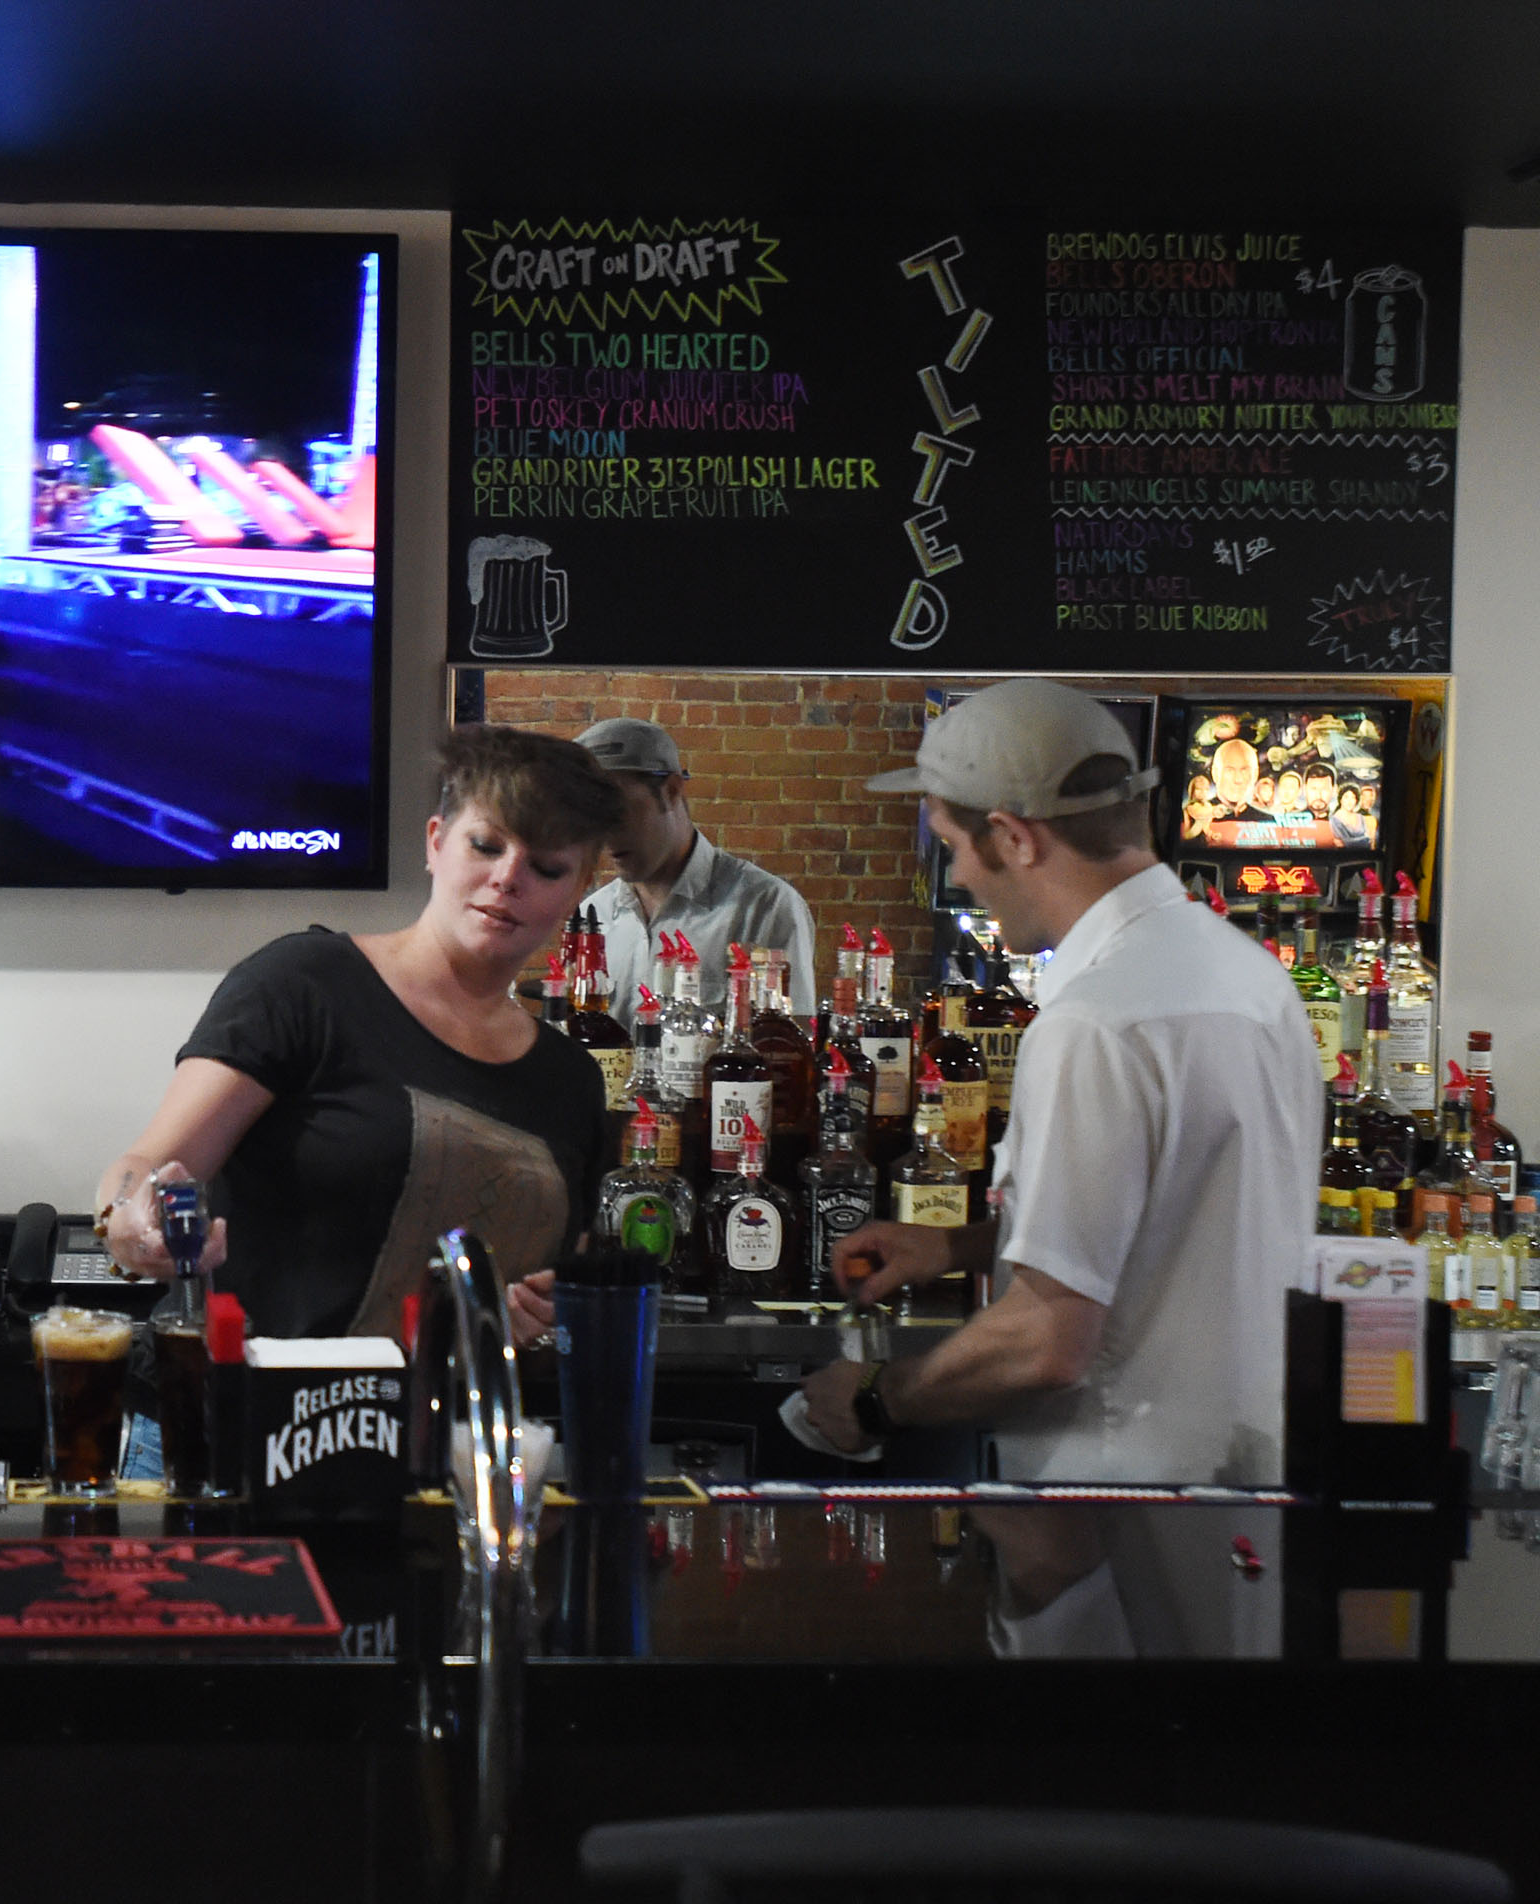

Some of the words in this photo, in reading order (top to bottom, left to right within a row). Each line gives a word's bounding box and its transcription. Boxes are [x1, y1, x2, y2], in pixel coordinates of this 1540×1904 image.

[1046, 232, 1158, 261] BREWDOG
[1164, 232, 1227, 261] ELVIS
[1236, 233, 1304, 262] JUICE
[490, 243, 596, 292] CRAFT
[635, 237, 741, 287] DRAFT
[1045, 261, 1125, 288] BELLS
[1133, 261, 1237, 289] OBERON
[1294, 258, 1343, 300] $4
[1045, 290, 1161, 319] FOUNDERS
[1046, 318, 1105, 345] NEW
[1372, 294, 1397, 395] CANS
[471, 331, 556, 367] BELLS
[564, 332, 630, 368] TWO
[641, 332, 770, 371] HEARTED
[1047, 346, 1125, 372] BELLS
[1136, 346, 1248, 372] OFFICIAL
[472, 367, 535, 397] NEW
[536, 368, 646, 400] BELGIUM
[772, 373, 810, 404] IPA
[1052, 375, 1148, 401] SHORTS
[1153, 375, 1222, 401] MELT
[1230, 375, 1267, 400] MY
[1273, 375, 1347, 400] BRAIN
[474, 398, 608, 430] PETOSKEY
[617, 400, 718, 431] CRANIUM
[722, 402, 796, 432] CRUSH
[1048, 405, 1129, 431] GRAND
[1134, 404, 1226, 431] ARMORY
[1234, 403, 1315, 430] NUTTER
[1326, 403, 1374, 429] YOUR
[474, 429, 542, 458] BLUE
[547, 430, 626, 458] MOON
[890, 235, 993, 651] TILTED
[472, 457, 557, 488] GRAND
[562, 457, 641, 489] RIVER
[647, 456, 694, 489] 313
[697, 456, 787, 489] POLISH
[794, 457, 880, 490] LAGER
[1048, 446, 1094, 474] FAT
[1096, 446, 1149, 474] TIRE
[1161, 446, 1243, 475] AMBER
[1248, 446, 1293, 475] ALE
[474, 487, 575, 517] PERRIN
[581, 487, 741, 520] GRAPEFRUIT
[753, 487, 789, 517] IPA
[1049, 478, 1208, 505] LEINENKUGELS
[1217, 478, 1316, 505] SUMMER
[1056, 549, 1148, 575] HAMMS
[1056, 577, 1123, 602] BLACK
[1129, 576, 1204, 600] LABEL
[1056, 604, 1127, 630] PABST
[1134, 604, 1188, 630] BLUE
[1192, 604, 1268, 631] RIBBON
[259, 830, 340, 855] NBCSN
[1306, 1008, 1339, 1022] MESON
[293, 1375, 378, 1425] RELEASE
[266, 1407, 399, 1487] KRAKEN
